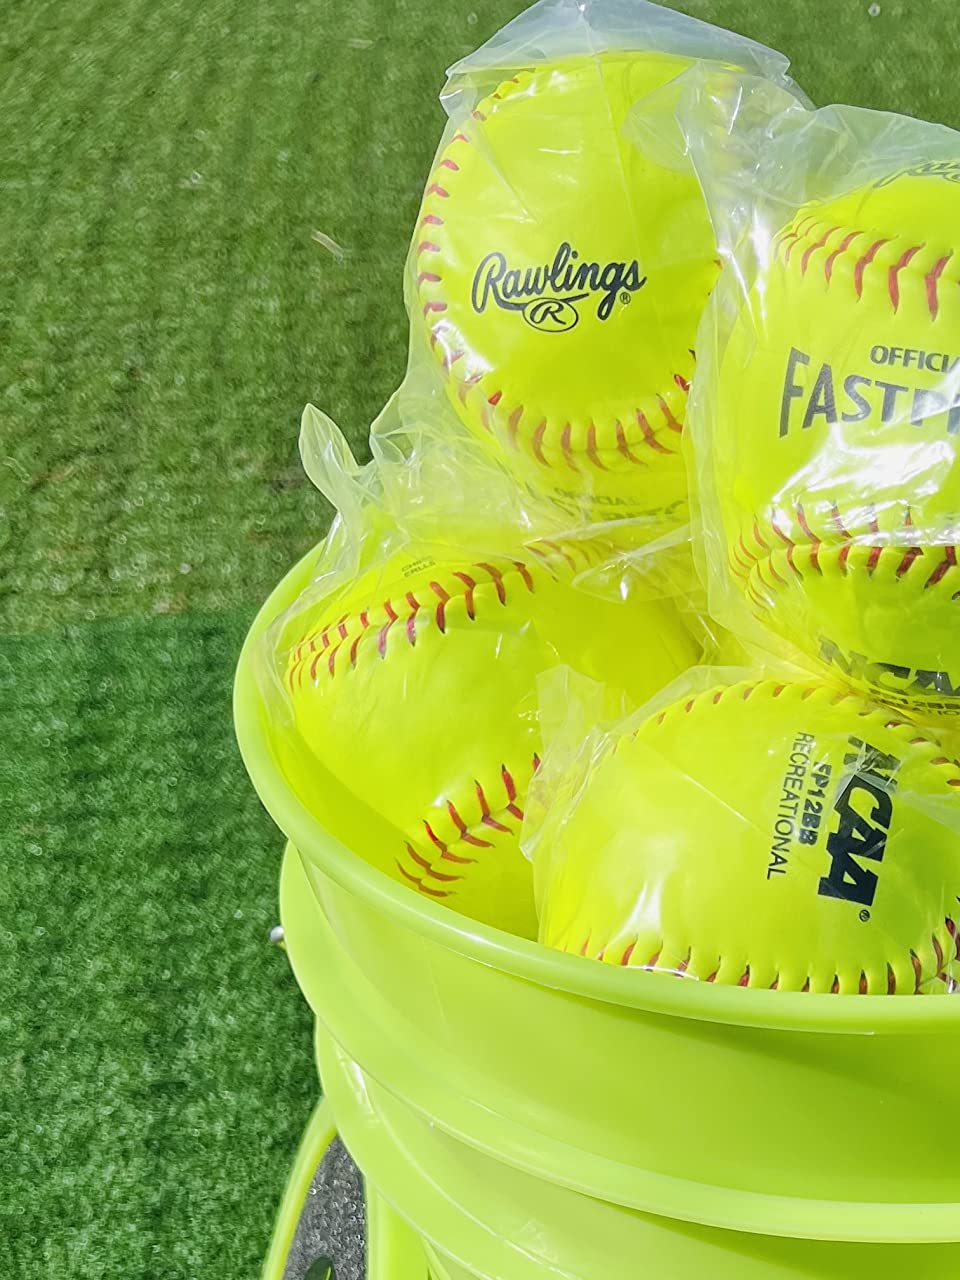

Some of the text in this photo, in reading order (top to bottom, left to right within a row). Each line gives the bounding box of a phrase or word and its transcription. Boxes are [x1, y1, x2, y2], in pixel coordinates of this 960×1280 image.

[471, 241, 648, 321] Rawlings
[767, 731, 816, 881] RECREATIONAL
[798, 760, 833, 846] FP12BB
[817, 735, 902, 907] NCAA
